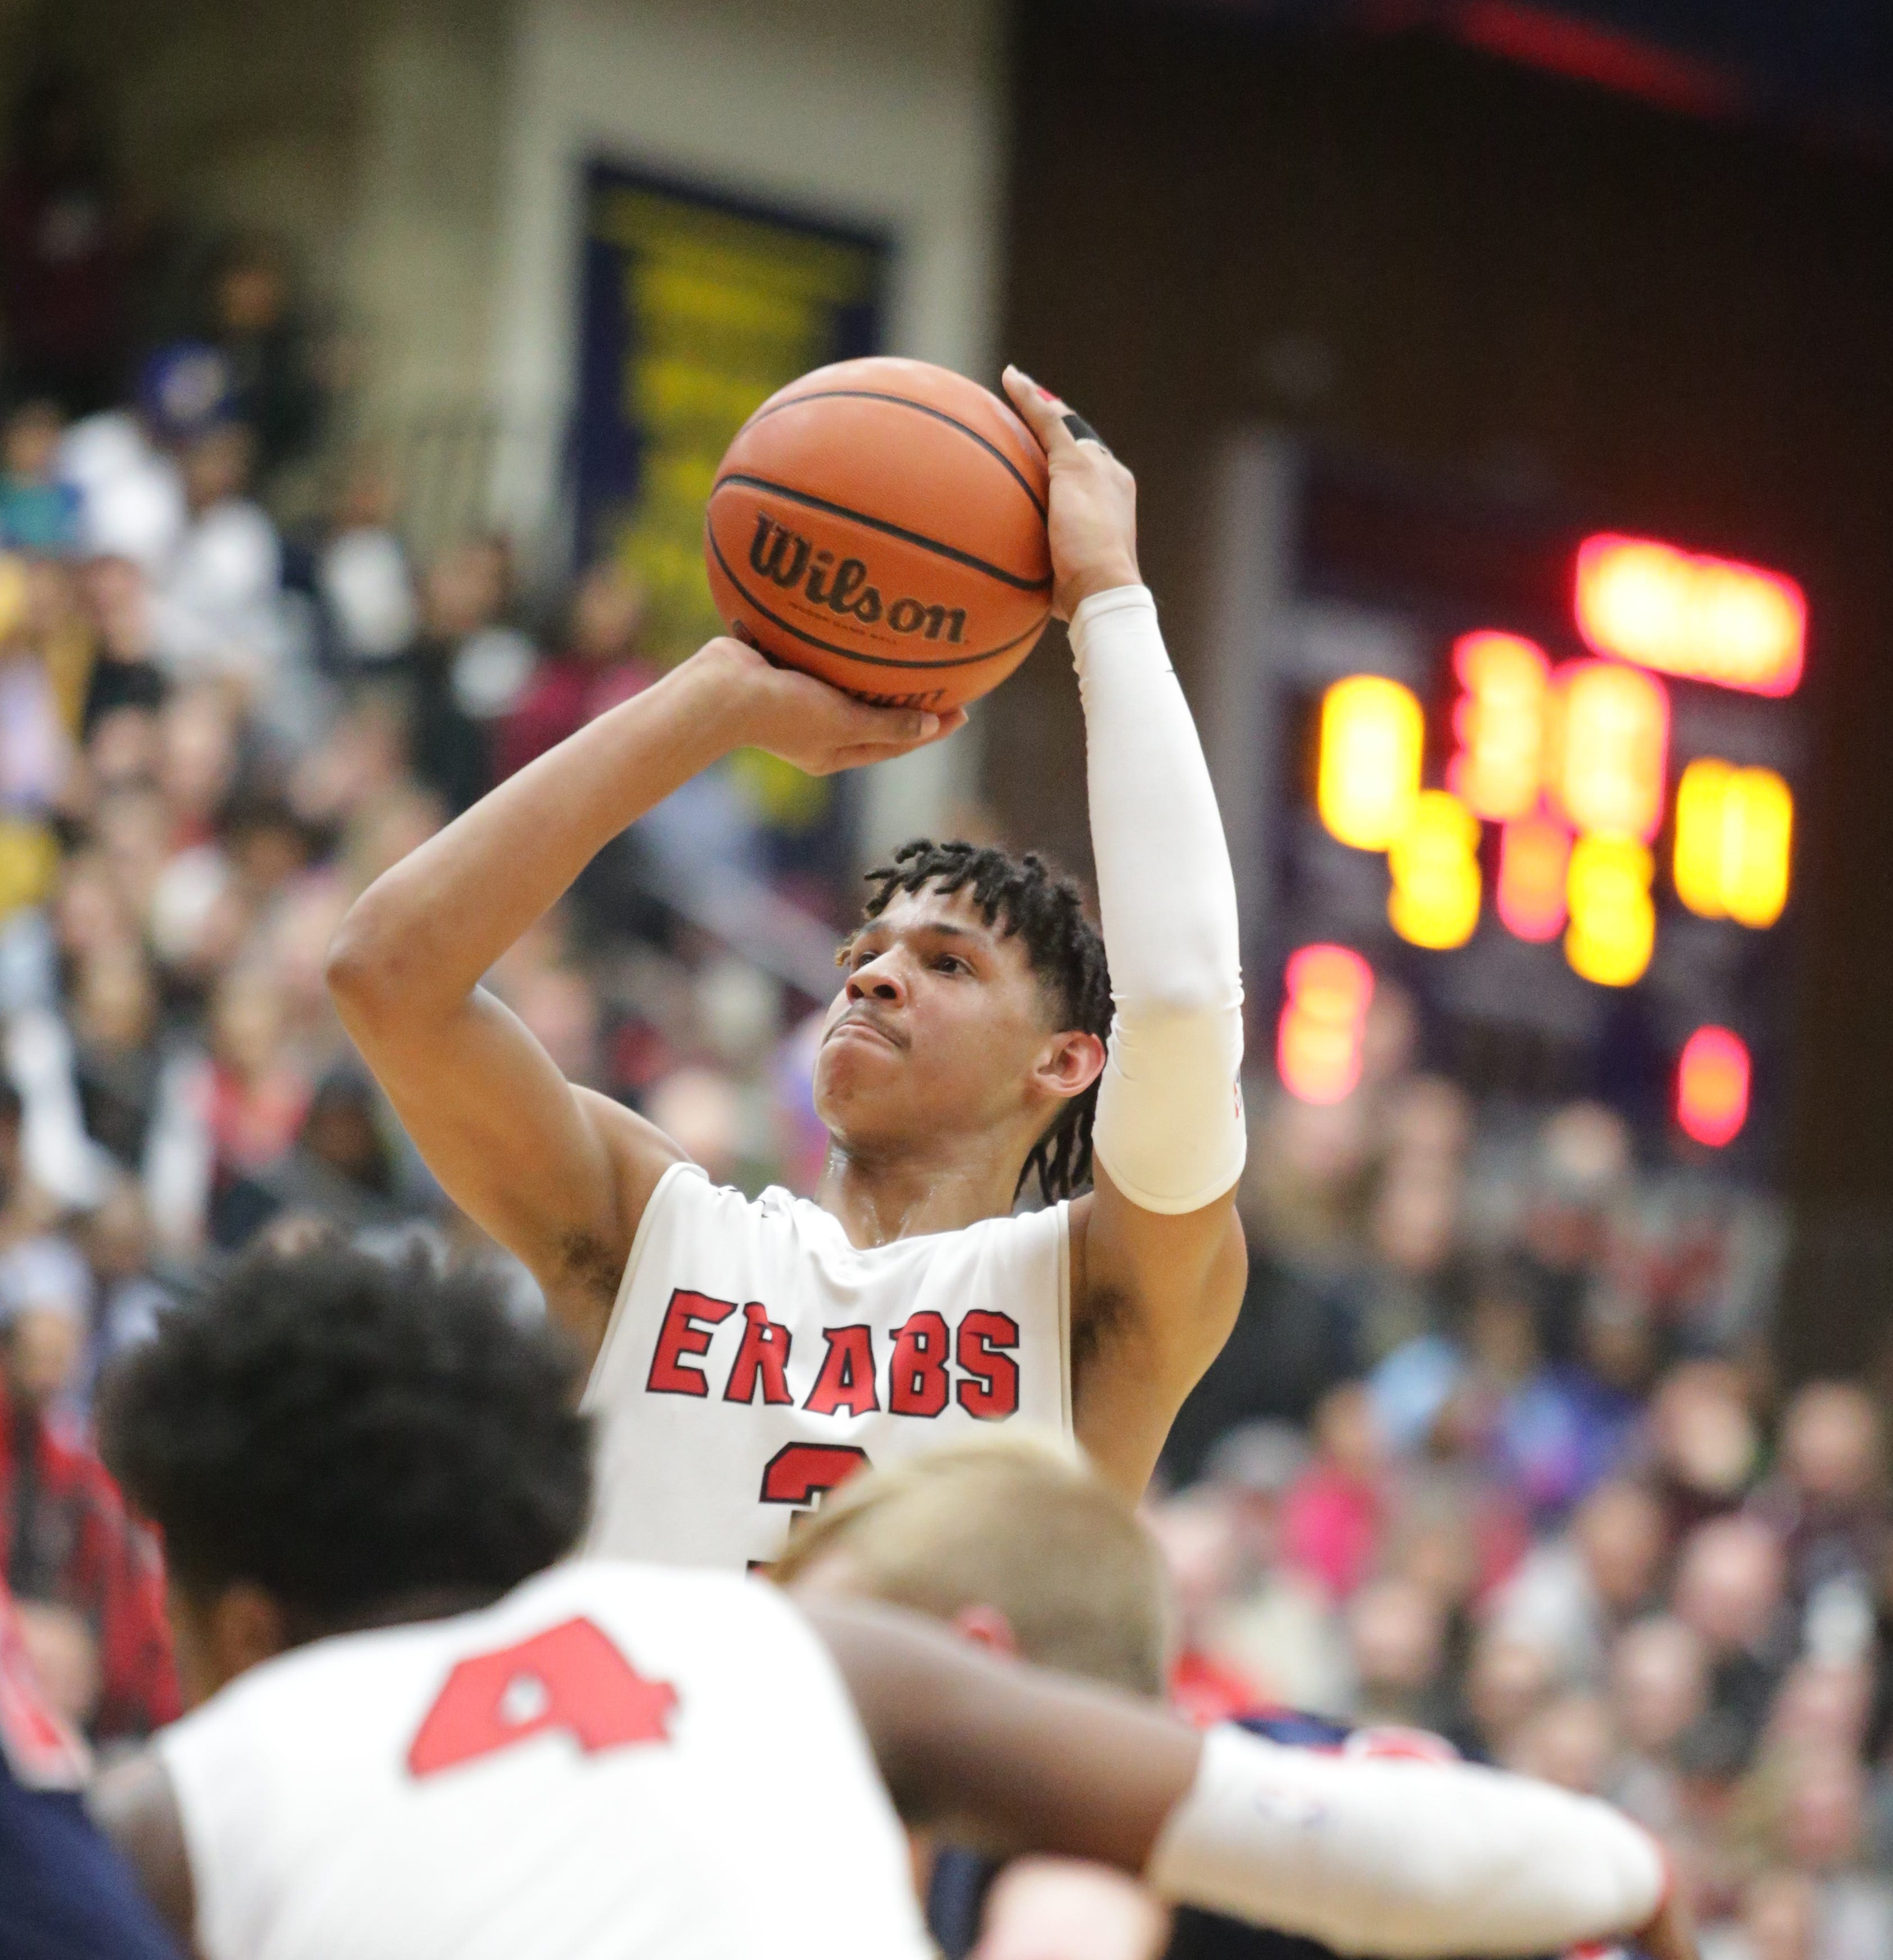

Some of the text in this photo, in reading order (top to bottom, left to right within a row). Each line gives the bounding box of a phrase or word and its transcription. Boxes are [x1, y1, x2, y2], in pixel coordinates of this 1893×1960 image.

[749, 511, 966, 644] Wilson
[645, 1288, 1020, 1420] ERABS
[405, 1615, 680, 1782] 4
